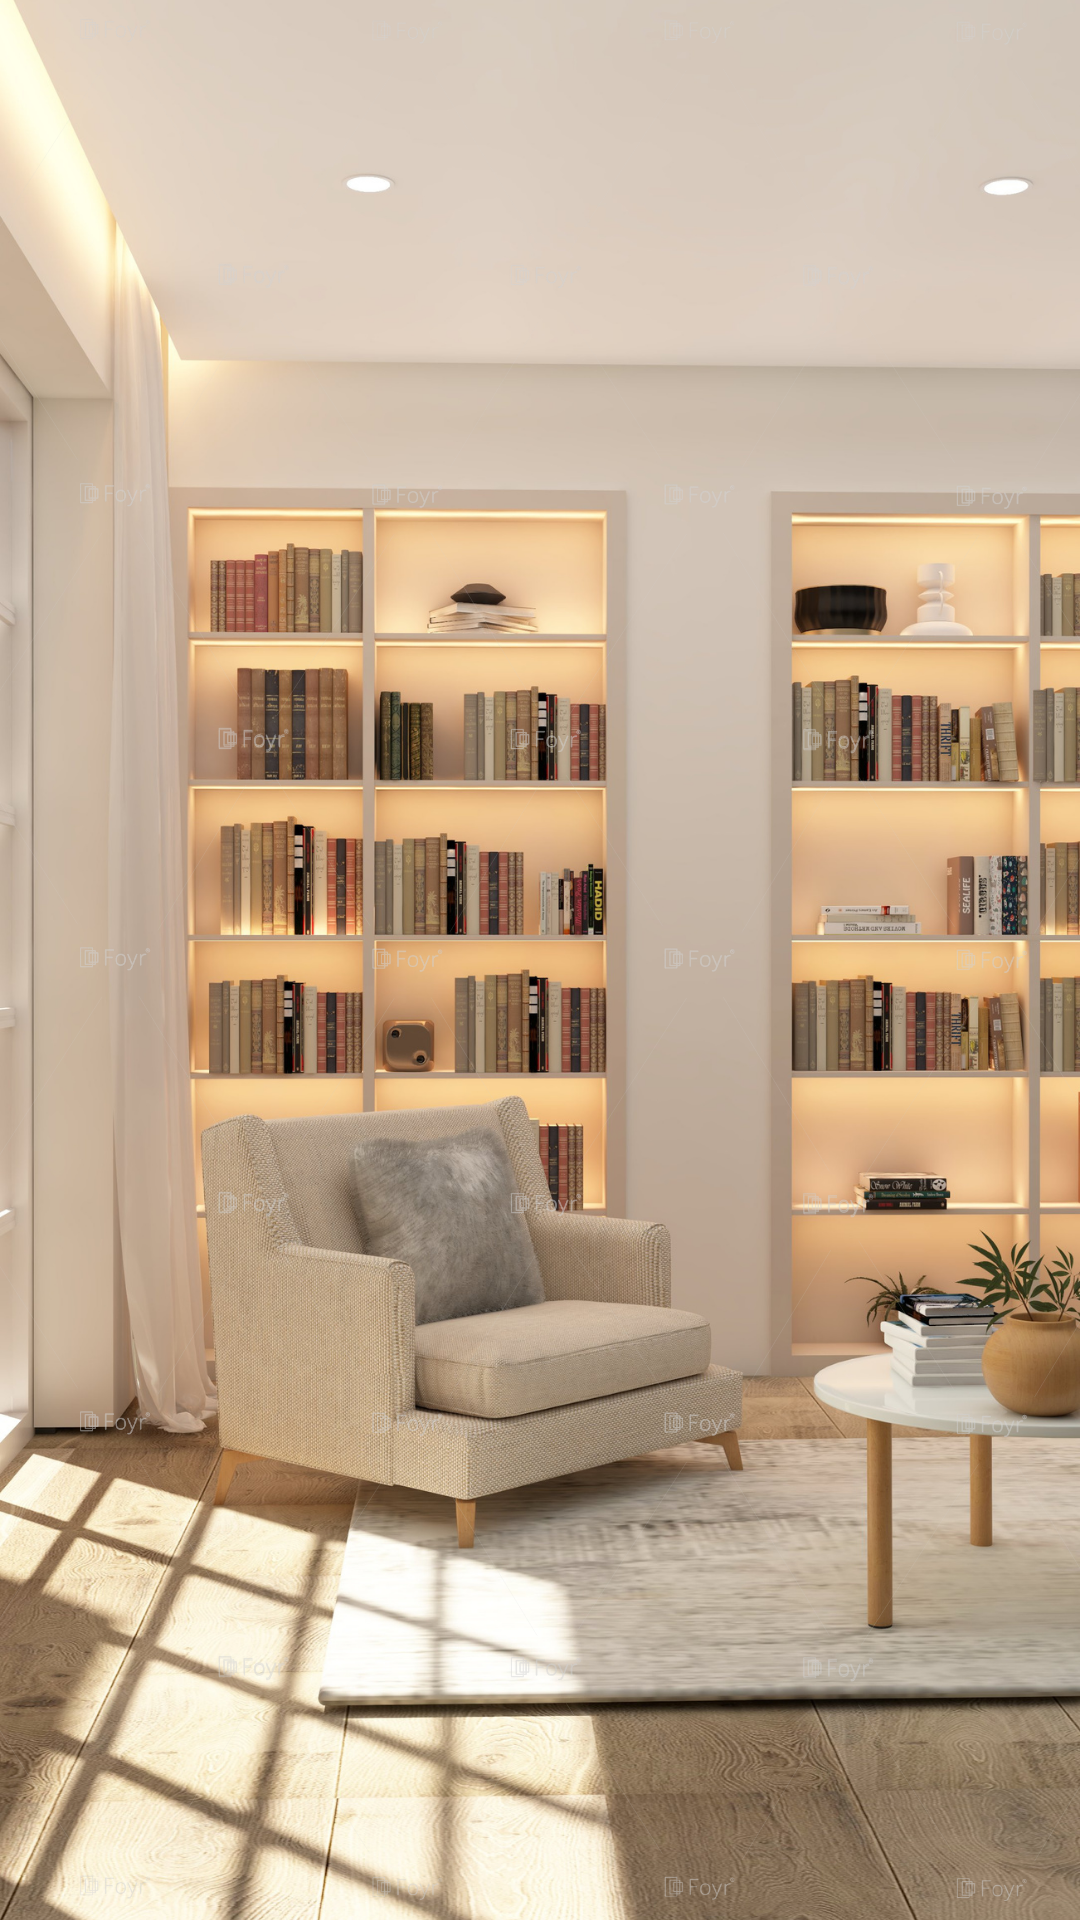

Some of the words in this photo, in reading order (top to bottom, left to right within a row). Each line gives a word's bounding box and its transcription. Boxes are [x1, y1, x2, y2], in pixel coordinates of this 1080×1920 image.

[940, 722, 951, 756] THRIFT
[594, 880, 602, 920] HADID
[962, 878, 970, 914] SEALIFE
[950, 1012, 962, 1046] THRIFT
